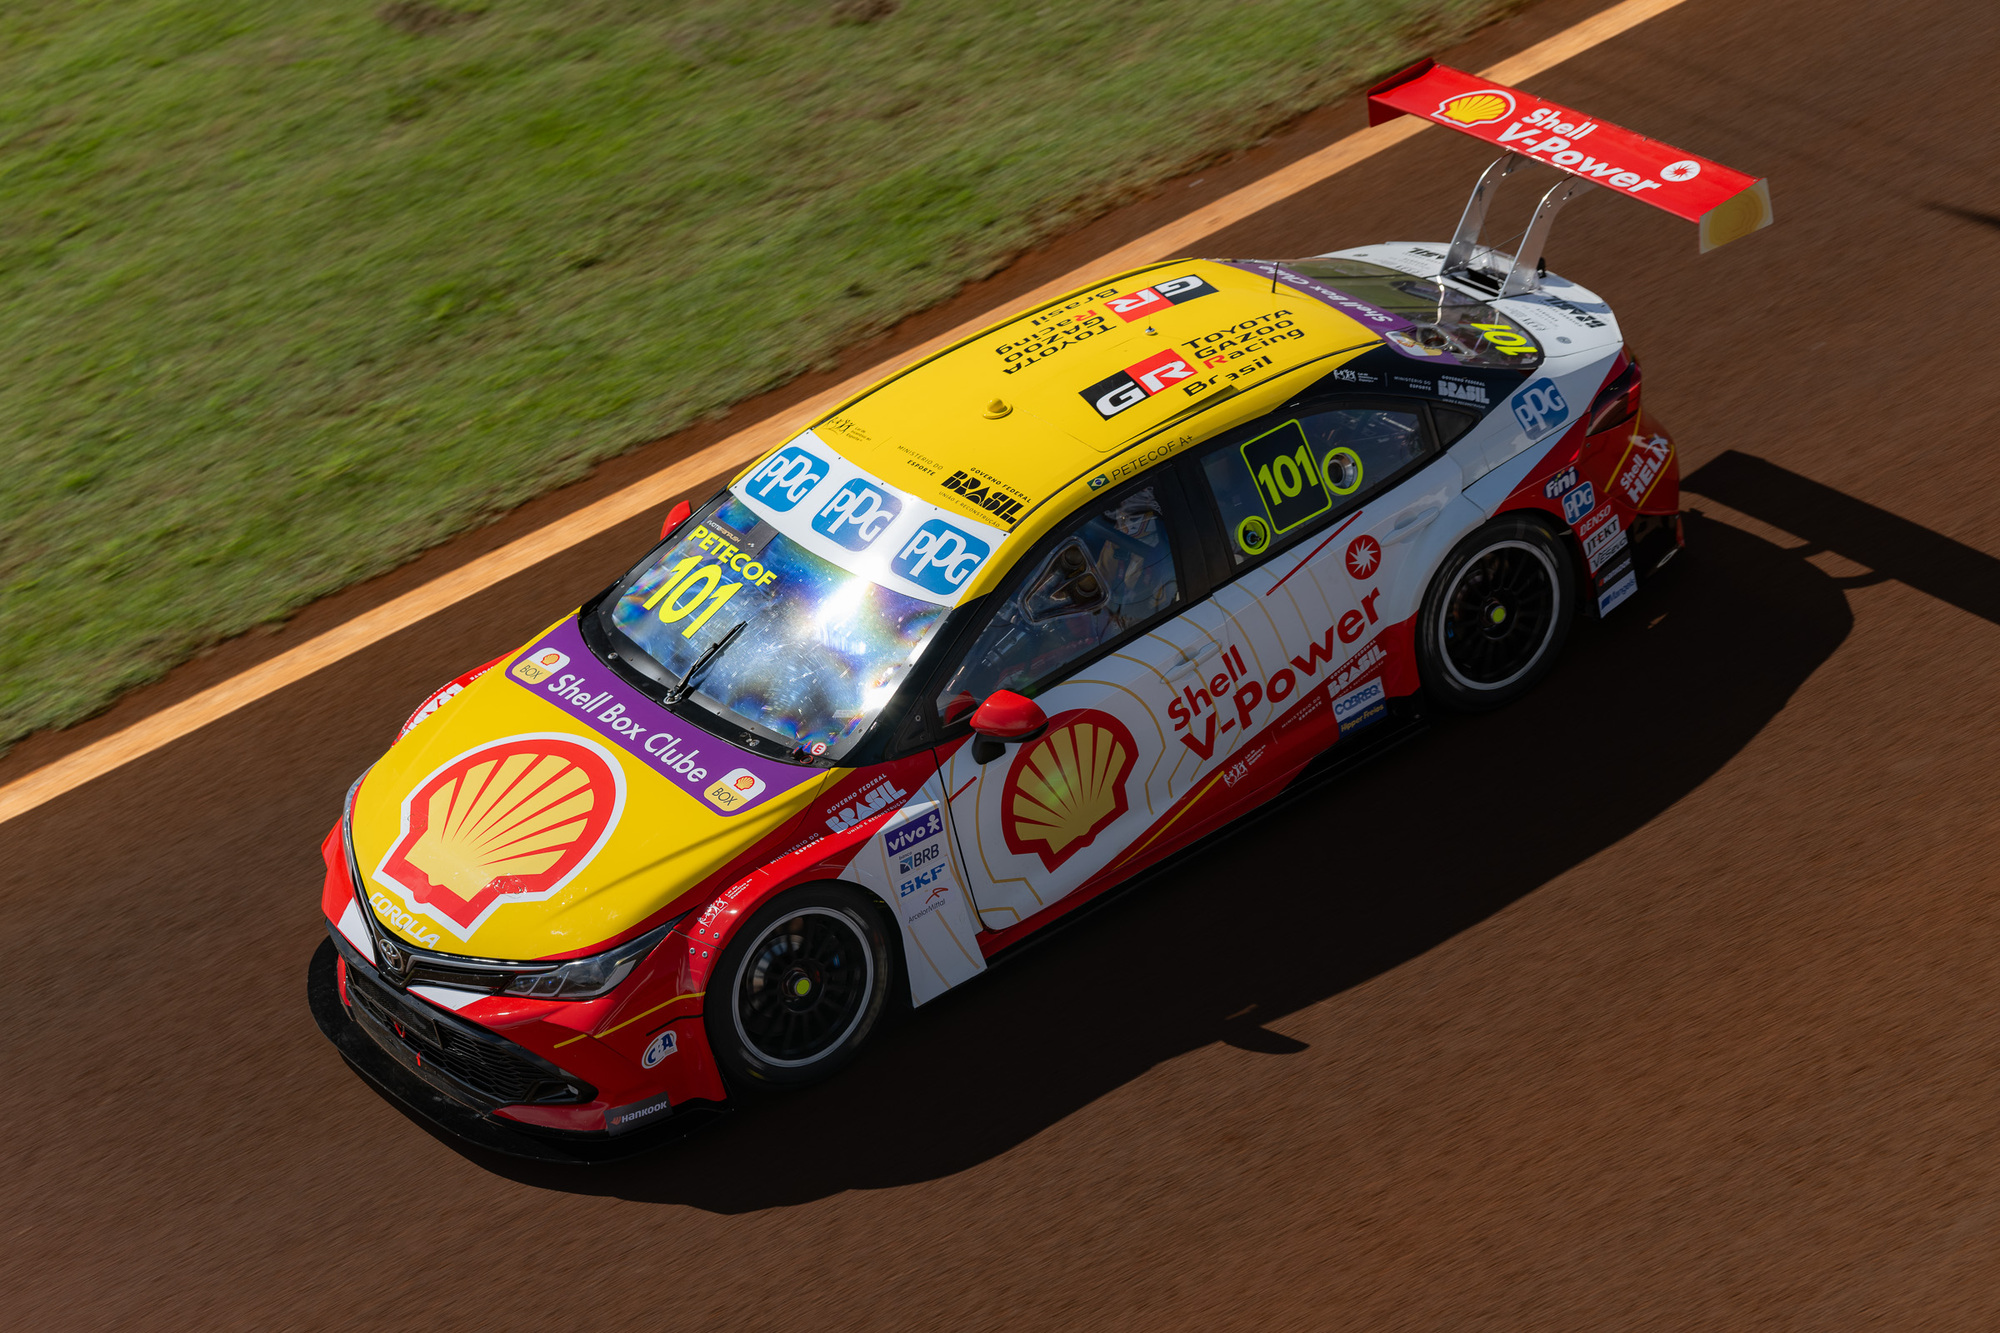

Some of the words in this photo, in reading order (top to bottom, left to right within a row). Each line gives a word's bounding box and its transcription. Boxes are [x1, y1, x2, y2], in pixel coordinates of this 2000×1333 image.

[1521, 107, 1599, 141] Shell
[1496, 122, 1663, 193] V-Power
[1031, 288, 1119, 326] Brasil
[1107, 275, 1204, 313] GR
[1309, 285, 1349, 301] Box
[1339, 301, 1393, 322] Shell
[995, 309, 1098, 356] Racing
[1004, 316, 1105, 363] GAZOO
[1181, 309, 1294, 349] TOYOTA
[1194, 319, 1295, 359] GAZOO
[1203, 328, 1305, 370] Racing
[1470, 322, 1538, 356] 101
[1002, 324, 1118, 375] TOYOTA
[1096, 360, 1195, 416] GR
[1182, 355, 1273, 397] Brasil
[1437, 379, 1490, 405] BRASIL
[1514, 384, 1566, 432] PPG
[754, 453, 821, 504] PPG
[906, 459, 936, 477] ESPORTE
[932, 461, 944, 471] DO
[1111, 440, 1177, 481] PETECOF
[1258, 444, 1319, 506] 101
[1620, 453, 1645, 491] Shell
[940, 469, 1025, 525] BRASIL
[970, 466, 1002, 486] GOVERNO
[1002, 483, 1032, 504] FEDERAL
[1564, 487, 1593, 519] PPG
[820, 486, 895, 543] PPG
[1579, 504, 1612, 537] DENSO
[687, 524, 778, 587] PETECOF
[1585, 519, 1618, 554] JTEKT
[898, 528, 982, 586] PPG
[642, 555, 744, 640] 101
[519, 664, 543, 680] BOX
[1168, 644, 1248, 732] Shell
[1180, 587, 1380, 762] V-Power
[1327, 644, 1388, 699] BRASIL
[1334, 684, 1381, 716] COBREQ
[547, 672, 614, 714] Shell
[596, 703, 647, 742] Box
[644, 731, 708, 783] Clube
[711, 787, 738, 807] BOX
[825, 779, 908, 835] BRASIL
[826, 792, 858, 815] GOVERNO
[858, 773, 887, 795] FEDERAL
[794, 836, 825, 856] ESPORTE
[809, 832, 820, 840] DO
[888, 826, 926, 851] vivo
[913, 843, 940, 868] BRB
[900, 862, 946, 898] SKF
[368, 891, 441, 949] COROLLA
[907, 898, 946, 924] ArcelorMittal
